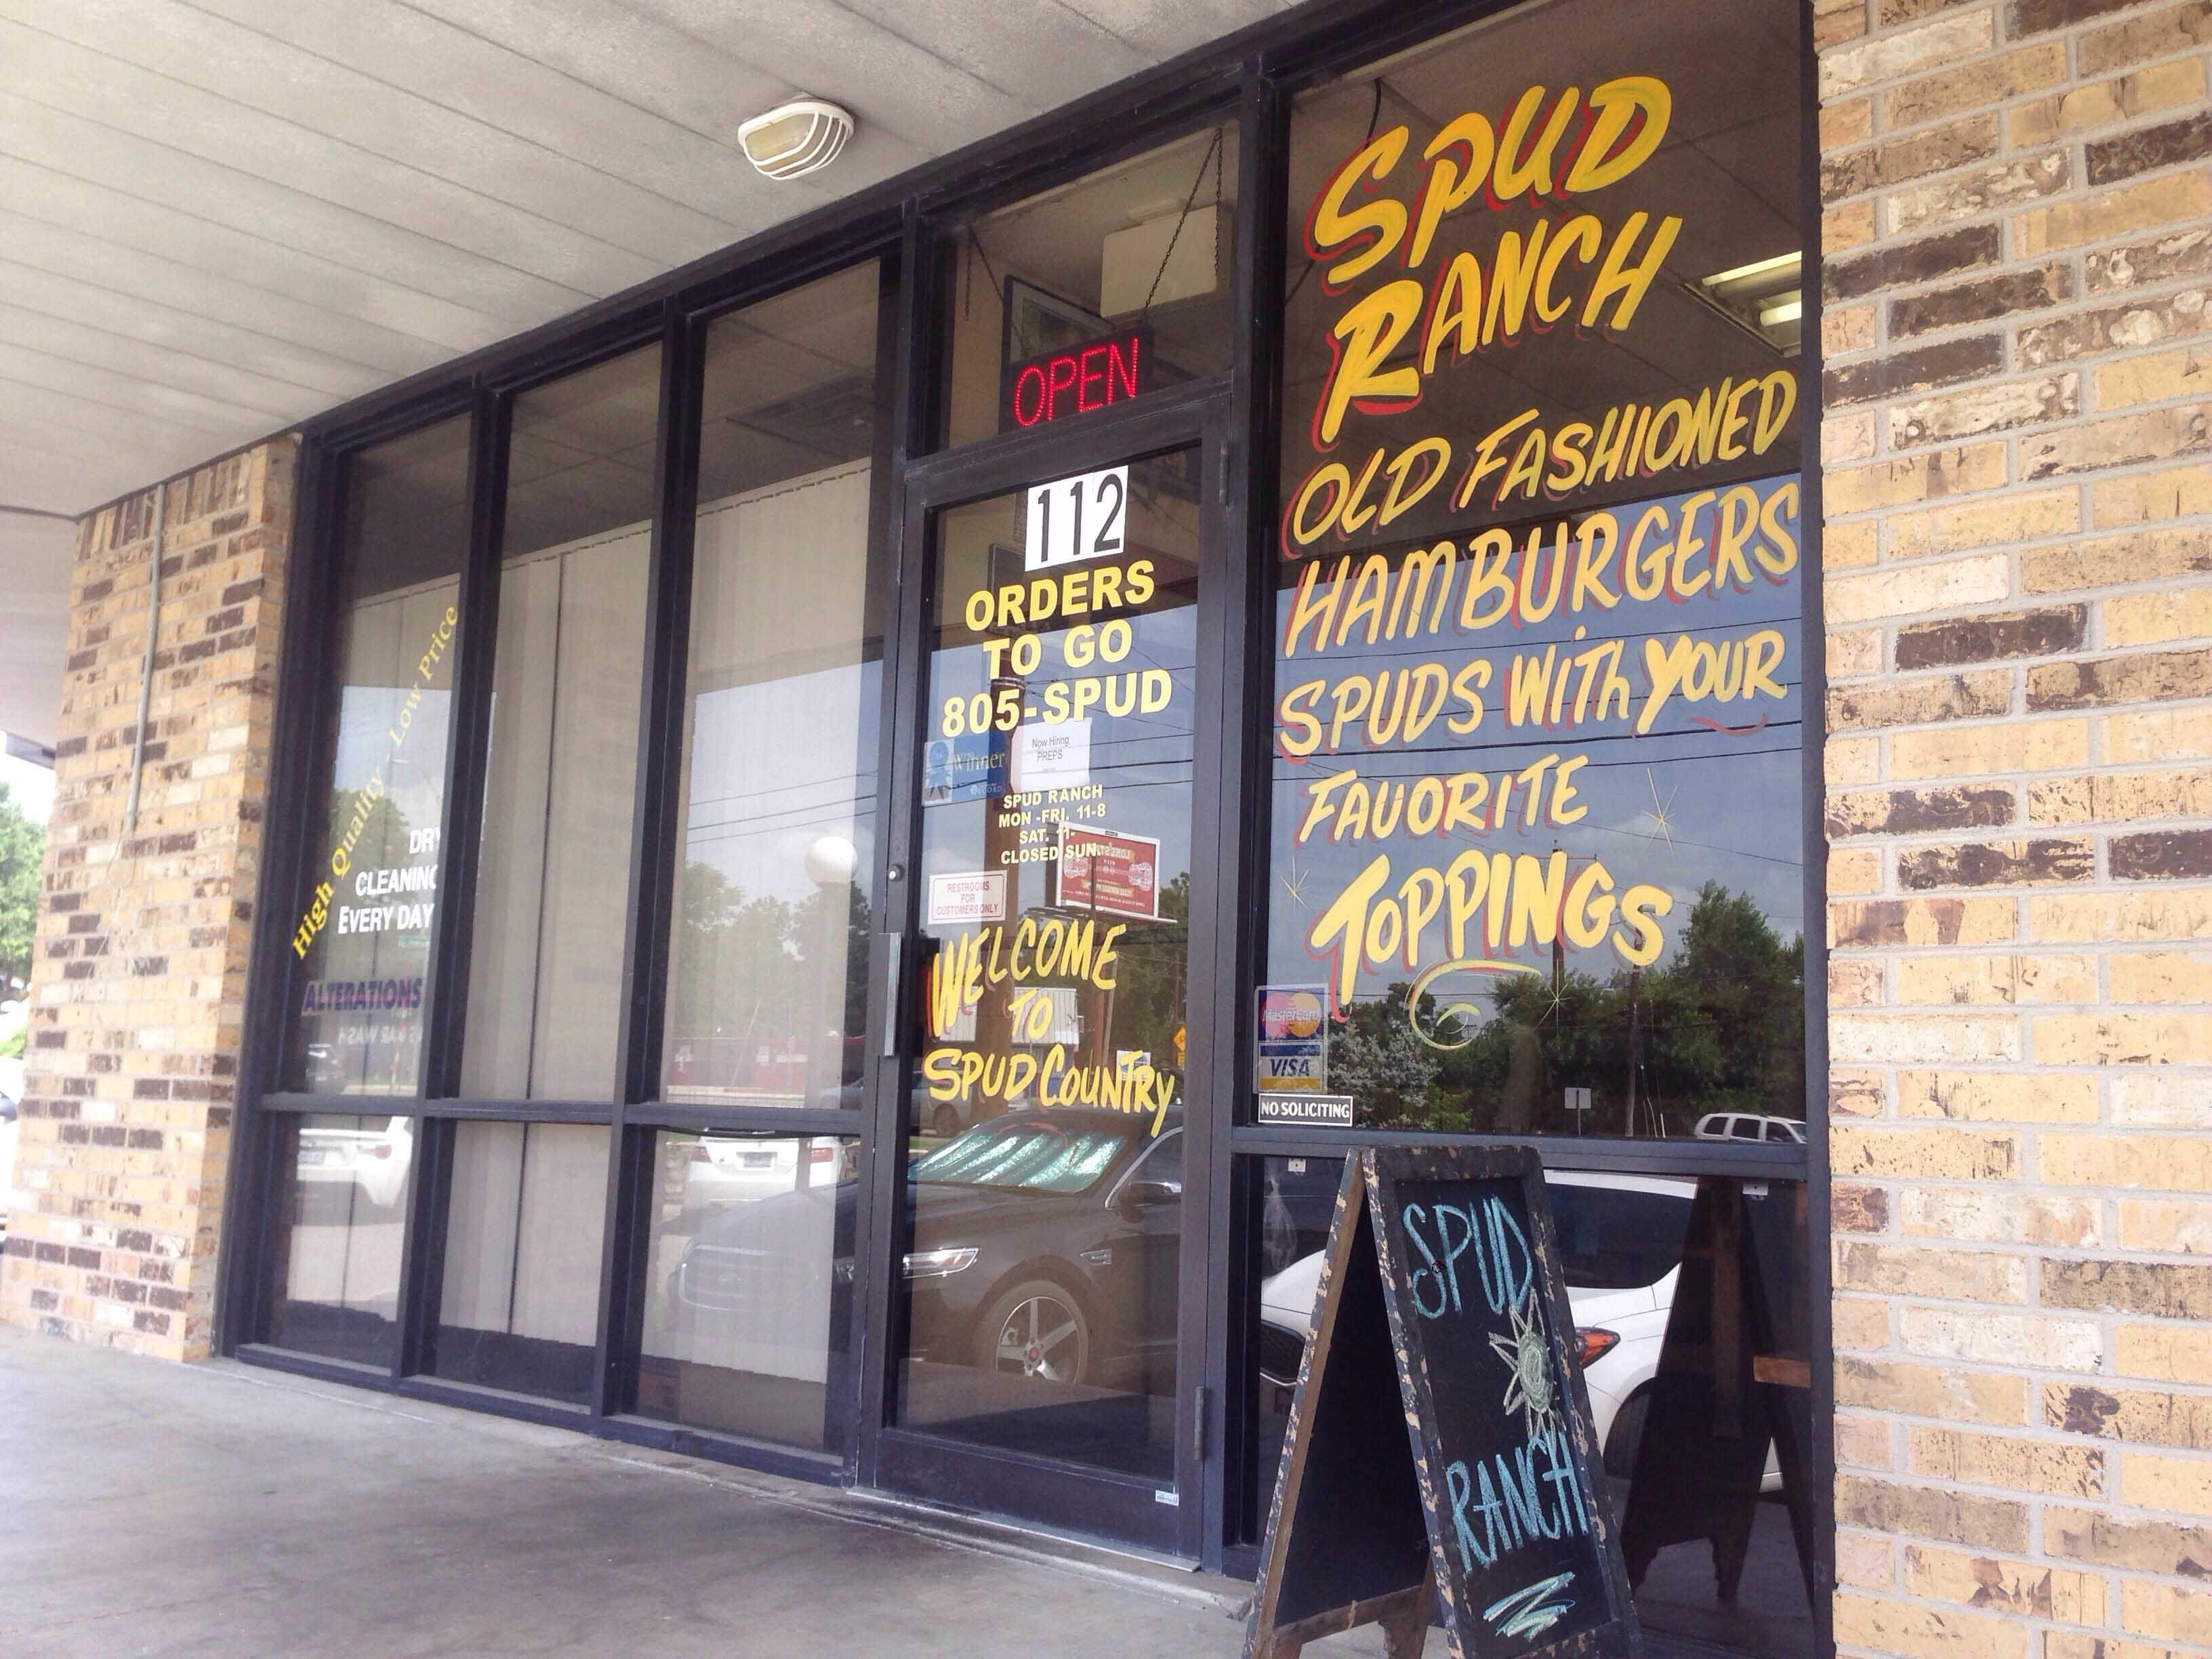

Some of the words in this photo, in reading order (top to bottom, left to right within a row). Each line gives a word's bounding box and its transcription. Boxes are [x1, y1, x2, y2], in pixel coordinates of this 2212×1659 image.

[1311, 76, 1672, 286] SPUD
[1319, 211, 1683, 444] RANCH
[1015, 337, 1138, 427] OPEN
[1291, 436, 1452, 546] OLD
[1458, 369, 1797, 509] FASHIONED
[1038, 474, 1124, 562] 112
[965, 559, 1155, 632] ORDERS
[1284, 482, 1800, 659] HAMBURGERS
[983, 634, 1042, 680] TO
[1063, 619, 1132, 669] GO
[942, 669, 1173, 738] 805-SPUD
[1279, 659, 1492, 757] SPUDS
[1635, 629, 1789, 735] YOUR
[952, 752, 1005, 772] Winner
[1032, 737, 1048, 749] Now
[1049, 736, 1069, 747] Hiring
[1037, 750, 1063, 761] PREPS
[292, 880, 334, 960] High
[388, 682, 422, 747] Low
[417, 607, 458, 682] Price
[1003, 791, 1042, 809] SPUD
[1048, 784, 1103, 804] RANCH
[998, 812, 1031, 828] MON
[1076, 803, 1106, 819] 11-8
[1019, 829, 1049, 844] SAT.
[1000, 847, 1059, 865] CLOSED
[1065, 842, 1101, 859] SUN.
[937, 905, 979, 916] CUSTOMERS
[980, 903, 998, 914] ONLY
[947, 880, 990, 893] RESTROOMS
[960, 894, 975, 903] FOR
[337, 905, 394, 935] EVERY
[396, 903, 435, 930] DAY
[1310, 849, 1673, 1006] TOPPINGS
[303, 977, 423, 1012] ALTERATIONS
[932, 917, 1127, 1038] WELCOME
[1008, 988, 1053, 1040] TO
[922, 1047, 1038, 1101] SPUD
[1039, 1043, 1175, 1138] COUNTRY
[1270, 1058, 1311, 1077] VISA
[1261, 1101, 1279, 1116] NO
[1281, 1101, 1350, 1118] SOLICITING
[1402, 1193, 1534, 1320] SPUD
[1446, 1429, 1589, 1574] RANCH
